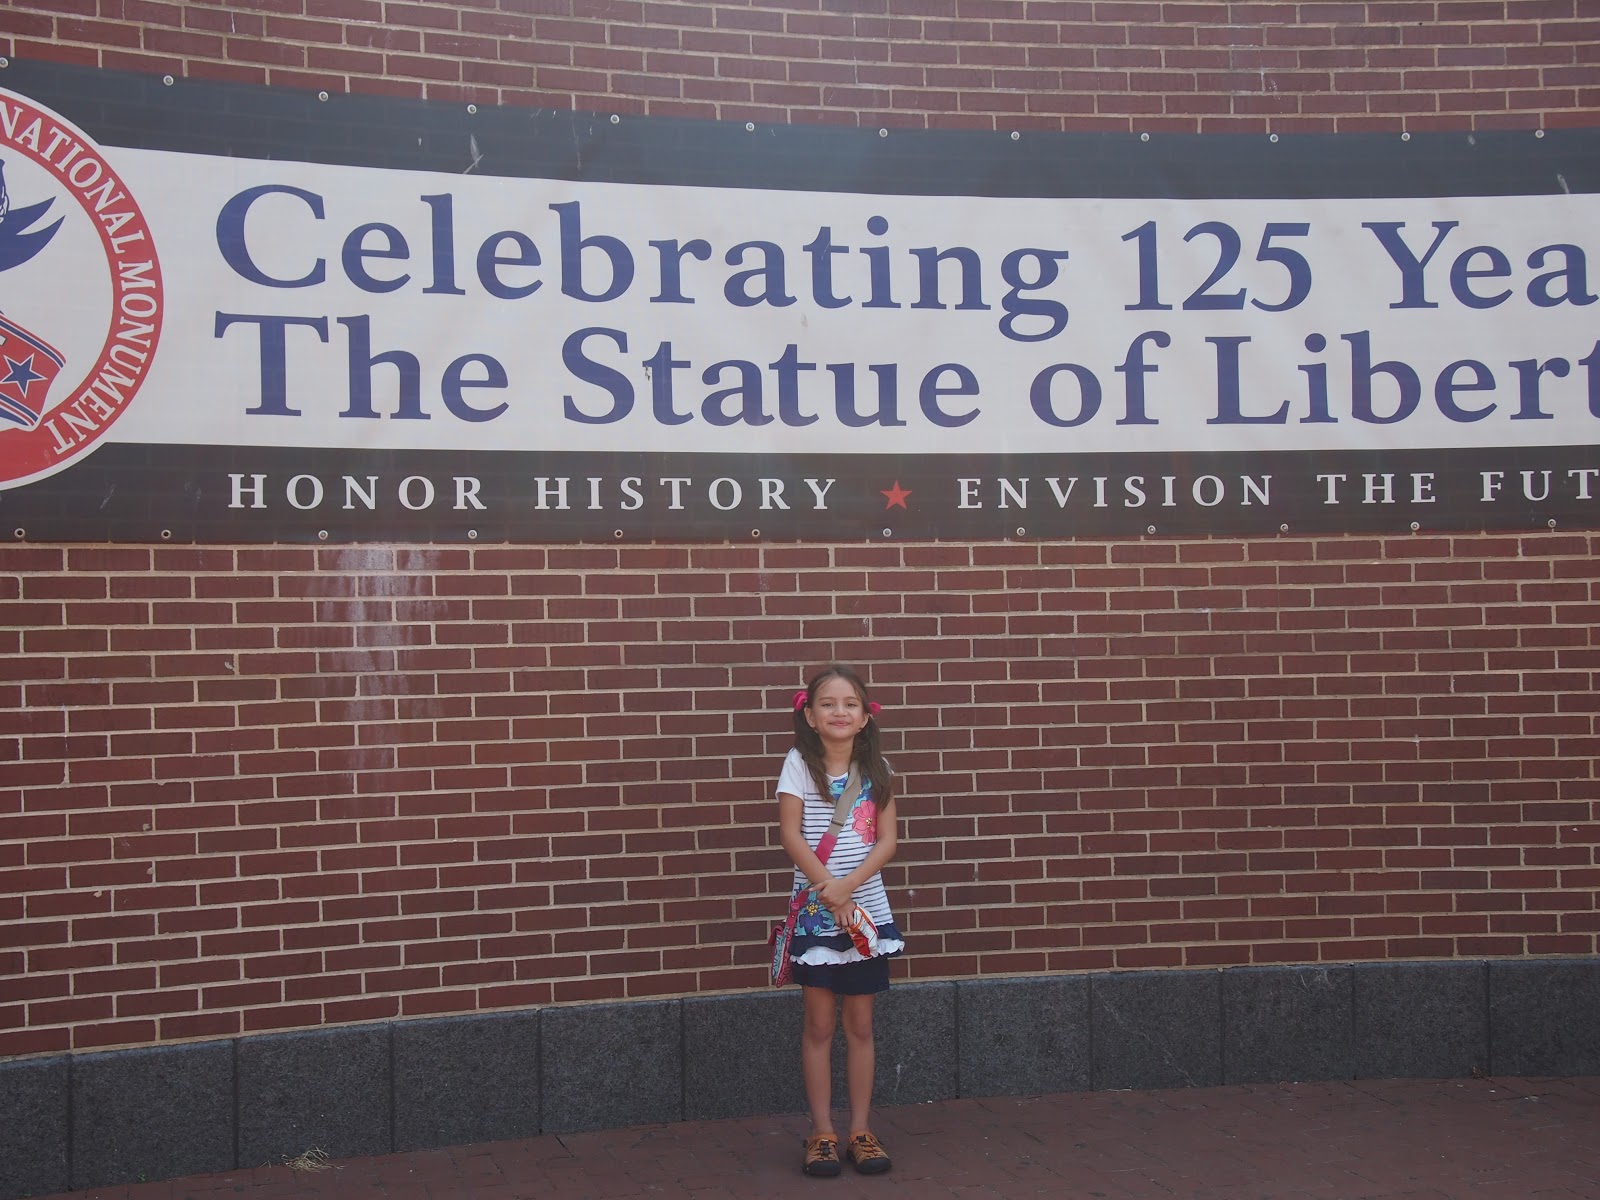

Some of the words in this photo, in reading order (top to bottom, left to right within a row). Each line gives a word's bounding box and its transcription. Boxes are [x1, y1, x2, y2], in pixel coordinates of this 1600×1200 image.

[0, 101, 145, 255] NATIONAL
[215, 184, 1070, 343] Celebrating
[1121, 220, 1312, 312] 125
[1361, 220, 1600, 310] Yea
[44, 260, 157, 455] MONUMENT
[214, 310, 510, 424] The
[563, 326, 981, 427] Statue
[1030, 330, 1172, 426] of
[227, 473, 489, 511] HONOR
[534, 476, 837, 511] HISTORY
[956, 474, 1273, 509] ENVISION
[1316, 472, 1437, 505] THE
[1479, 468, 1600, 503] FUT
